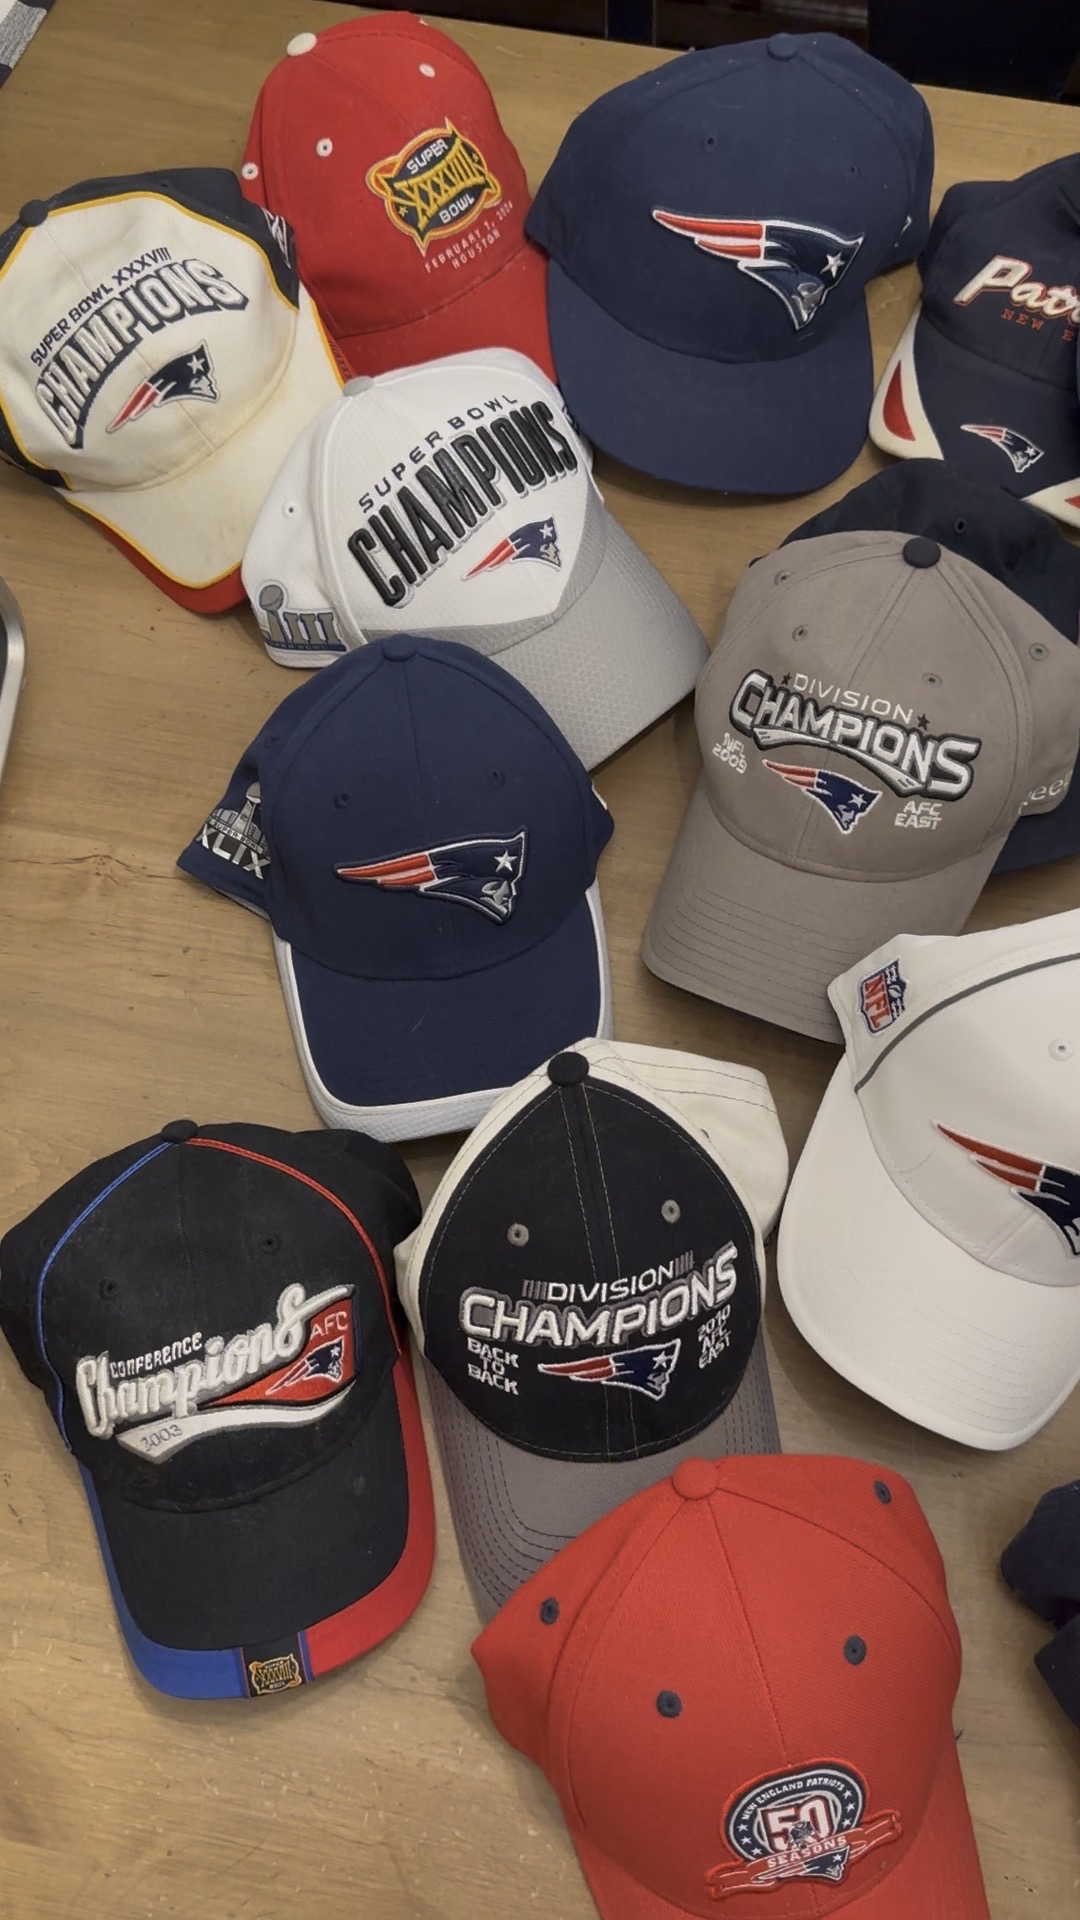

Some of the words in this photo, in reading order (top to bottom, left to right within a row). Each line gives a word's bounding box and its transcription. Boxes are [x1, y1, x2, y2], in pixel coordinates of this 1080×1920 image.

[406, 139, 449, 174] SUPER
[393, 137, 486, 231] XXXVIII
[439, 194, 475, 224] BOWL
[424, 229, 481, 273] FEBRUARY
[452, 229, 501, 269] HOUSTON
[31, 318, 71, 366] SUPER
[68, 284, 113, 323] BOWL
[112, 247, 172, 286] XXXVIII
[1001, 308, 1044, 330] NEW
[35, 259, 249, 449] CHAMPIONS
[358, 431, 443, 513] SUPER
[447, 394, 518, 430] BOWL
[347, 400, 579, 608] CHAMPIONS
[793, 673, 914, 725] DIVISION
[723, 732, 746, 759] NFL
[730, 669, 981, 800] CHAMPIONS
[711, 743, 748, 774] 2009
[894, 813, 942, 830] EAST
[903, 800, 943, 816] AFC
[212, 820, 239, 839] SUPER
[196, 823, 271, 880] XLIX
[864, 974, 891, 1029] NFL
[459, 1240, 738, 1349] CHAMPIONS
[546, 1261, 674, 1303] DIVISION
[310, 1310, 349, 1340] AFC
[698, 1304, 731, 1341] 2010
[701, 1322, 727, 1354] AFC
[76, 1282, 354, 1440] Champions
[109, 1332, 203, 1379] CONFERENCE
[467, 1338, 519, 1368] BACK
[482, 1355, 505, 1375] TO
[699, 1337, 732, 1370] EAST
[468, 1364, 519, 1396] BACK
[140, 1425, 183, 1452] 2003
[741, 1802, 758, 1821] NEW
[757, 1781, 804, 1804] ENGLAND
[806, 1777, 845, 1791] PATRIOTS
[761, 1794, 832, 1852] 50
[767, 1835, 847, 1868] SEASONS
